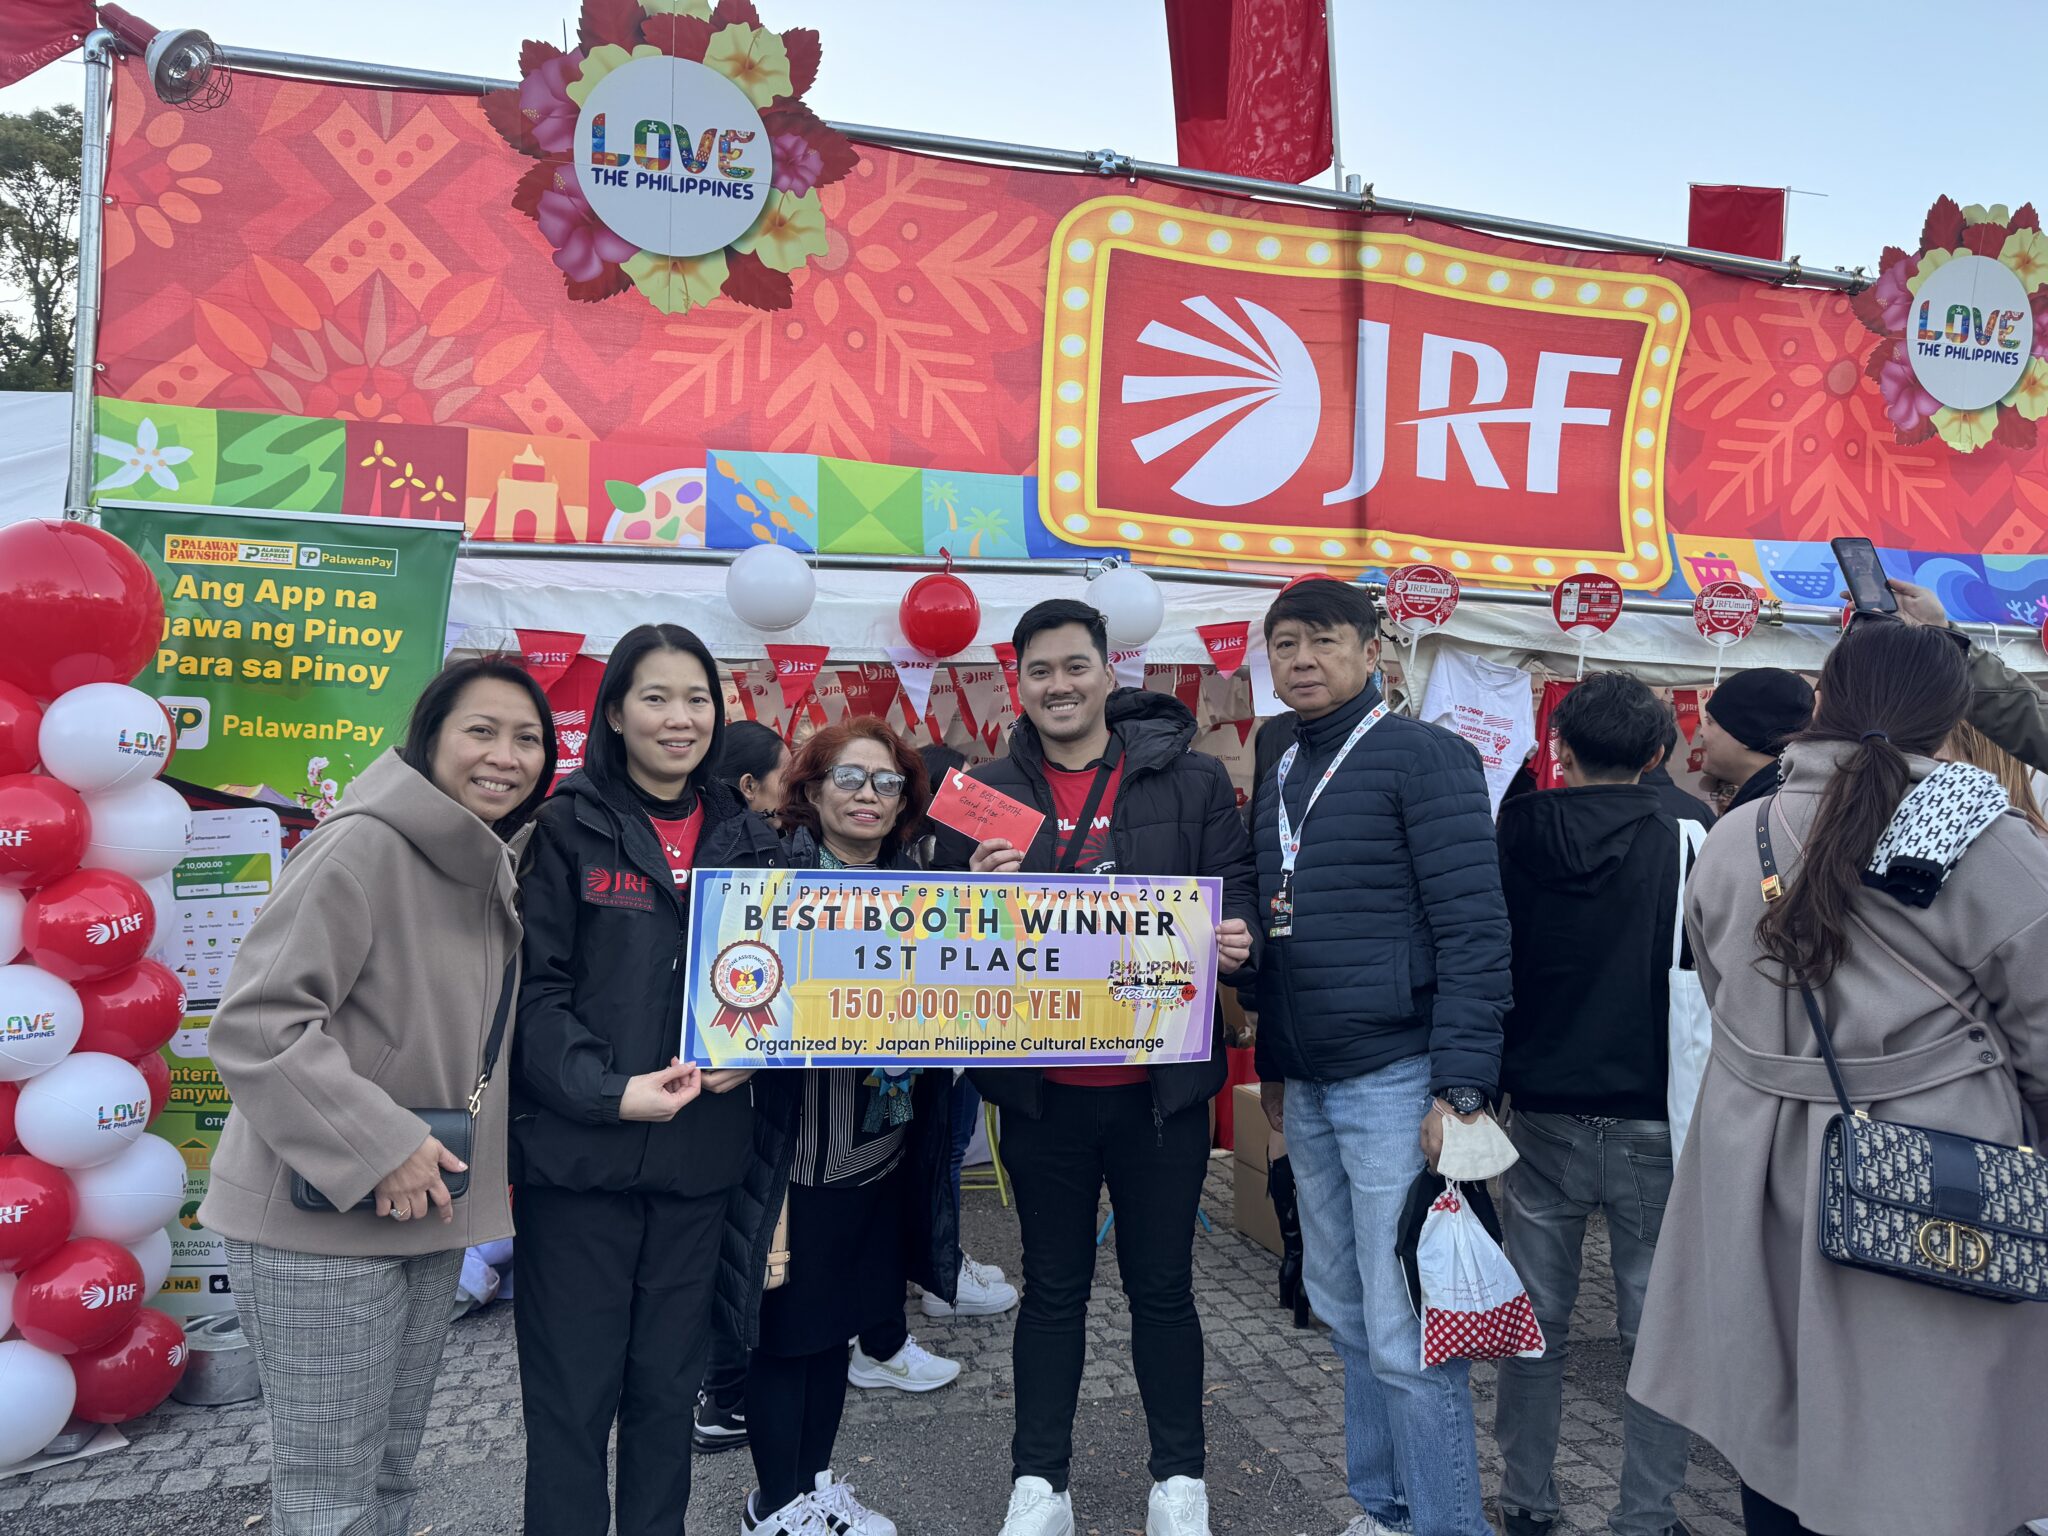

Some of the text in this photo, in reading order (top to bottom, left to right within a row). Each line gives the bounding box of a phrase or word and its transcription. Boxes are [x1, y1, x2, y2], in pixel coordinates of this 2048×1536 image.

[591, 112, 755, 181] LOVE
[590, 167, 754, 201] THE PHILIPPINES
[1917, 300, 2024, 349] LOVE
[1917, 342, 2019, 366] THE PHILIPPINES
[1323, 317, 1623, 506] JRF
[170, 548, 238, 562] PAWNSHOP
[181, 539, 239, 552] PALAWAN
[321, 553, 393, 569] PalawanPay
[173, 574, 377, 612] Ang App na
[1408, 583, 1450, 595] JRFUmart
[1714, 599, 1751, 610] JRFUmart
[251, 620, 295, 648] ng
[304, 618, 403, 654] Pinoy
[1221, 635, 1244, 651] JRF
[543, 652, 571, 664] JRF
[1119, 650, 1142, 663] JRF
[156, 648, 390, 690] Para sa Pinoy
[974, 671, 994, 684] JRF
[1154, 664, 1175, 676] JRF
[118, 729, 167, 752] LOVE
[222, 714, 385, 746] PalawanPay
[118, 746, 131, 754] THE
[612, 871, 653, 894] JRF
[721, 882, 1200, 905] Philippine Festival Tokyo 2024
[111, 912, 144, 941] JRF
[744, 905, 1176, 937] BEST BOOTH WINNER
[854, 945, 1061, 972] 1ST PLACE
[1109, 959, 1196, 975] PHILIPPINE
[1113, 984, 1178, 1002] Festival
[828, 987, 1082, 1022] 150,000.00 YEN
[0, 1012, 56, 1035] OVE
[7, 1030, 55, 1042] PHILIPPINES
[745, 1036, 1165, 1055] Organized by: Japan Philippine Cultural Exchange
[98, 1099, 146, 1124] LOVE
[97, 1123, 113, 1131] THE
[172, 1249, 210, 1257] ABROAD
[187, 1240, 223, 1249] PADALA
[104, 1283, 137, 1308] JRF
[174, 1280, 199, 1290] NA!
